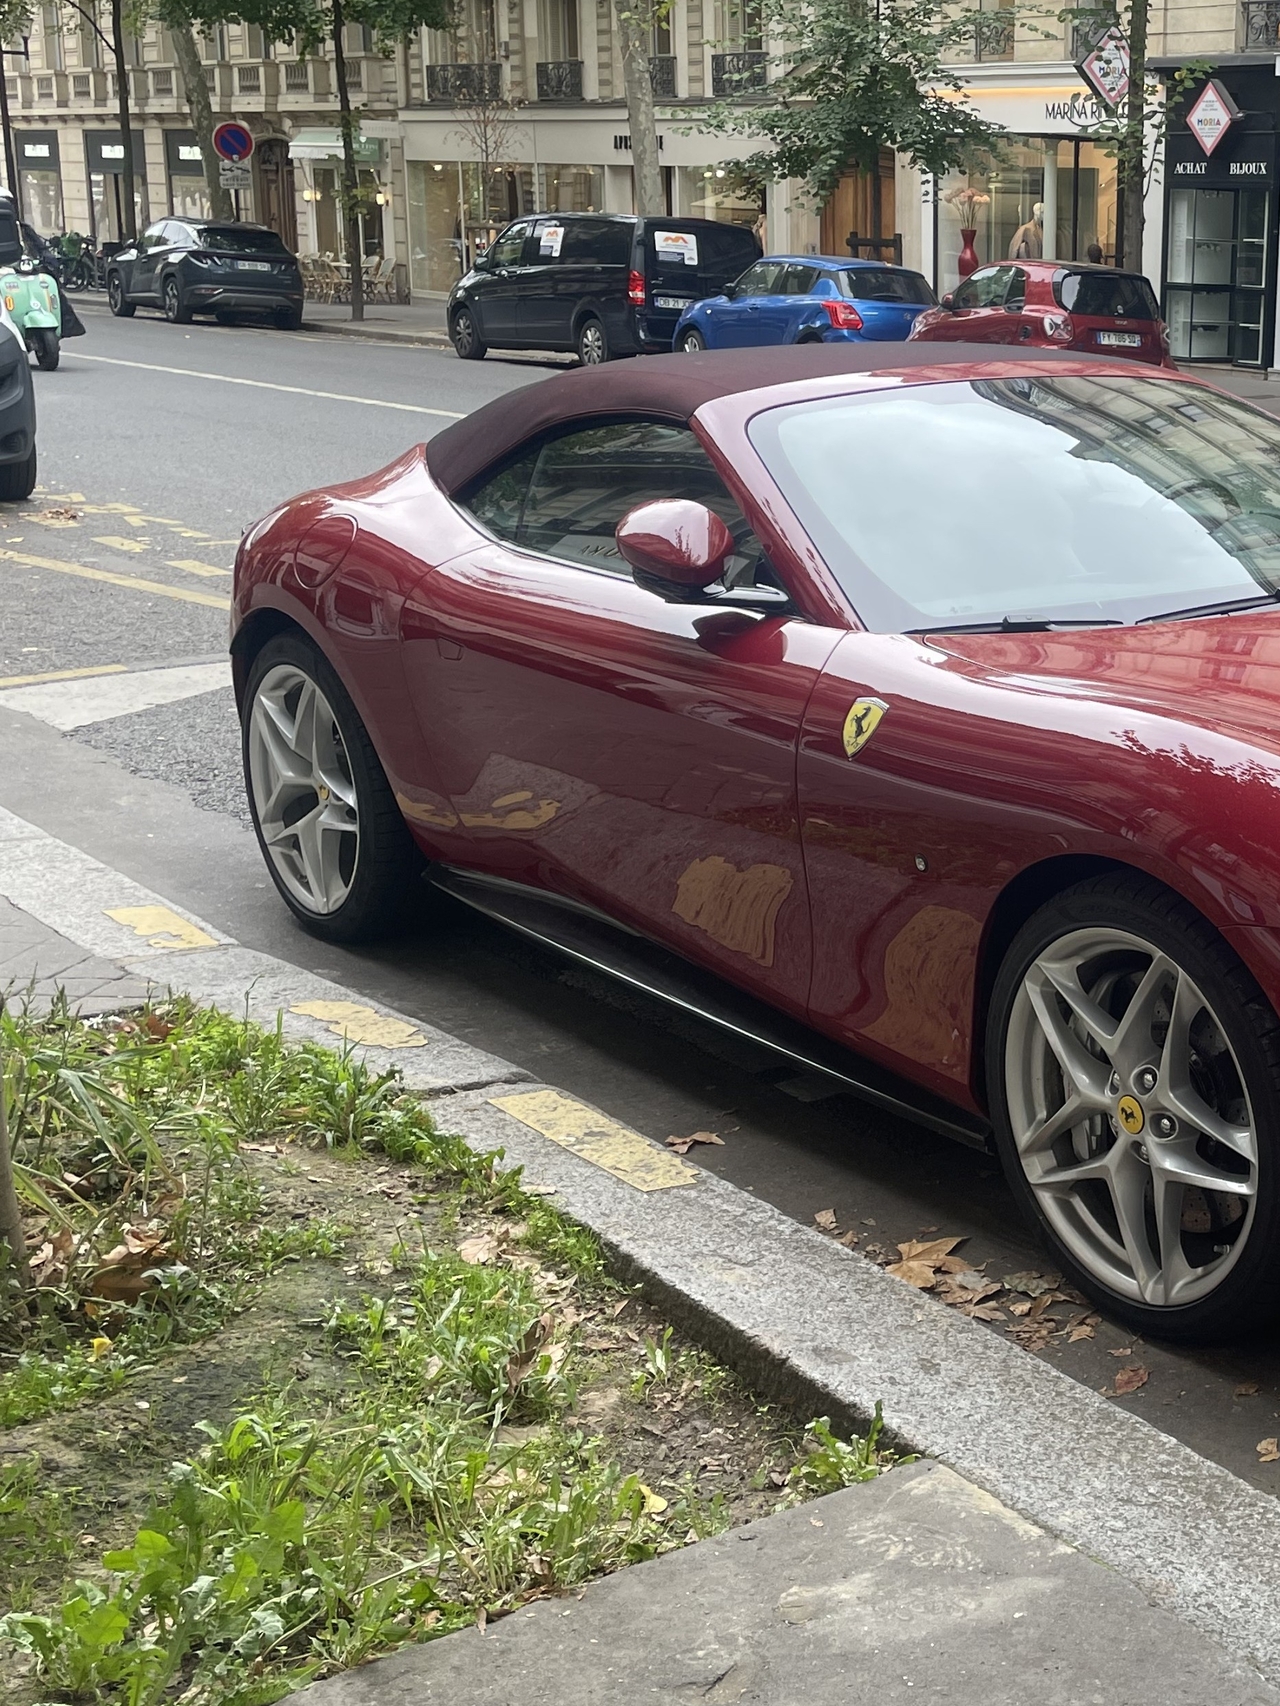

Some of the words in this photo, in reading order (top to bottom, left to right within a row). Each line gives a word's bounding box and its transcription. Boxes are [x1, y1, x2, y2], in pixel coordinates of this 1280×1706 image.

[1045, 102, 1088, 120] MARINA
[1197, 118, 1221, 127] MORIA
[1174, 162, 1207, 174] ACHAT
[1229, 162, 1268, 175] BIJOUX
